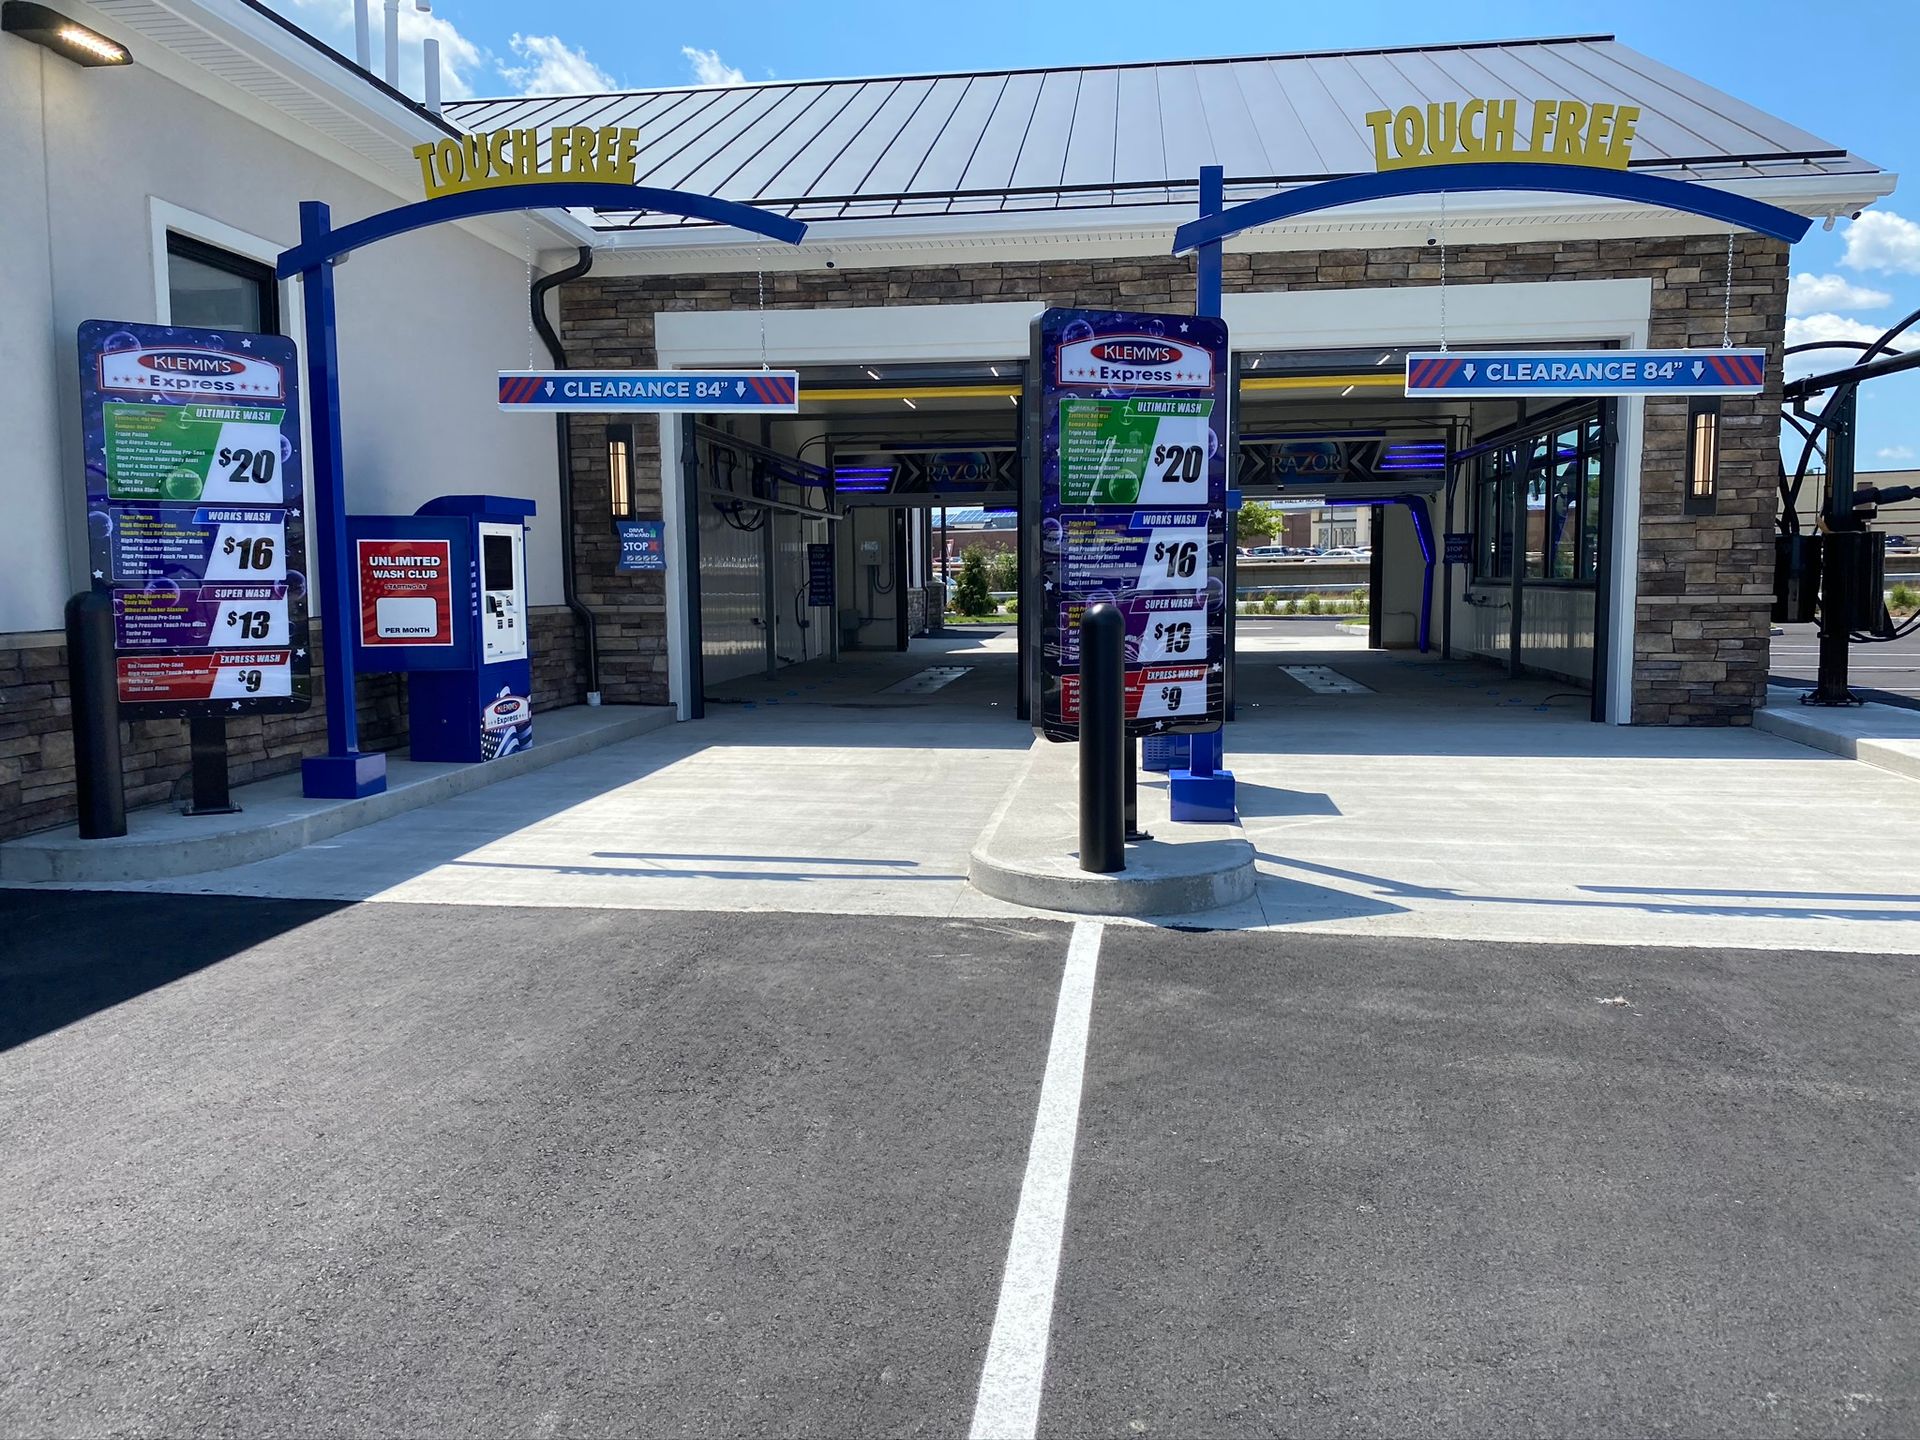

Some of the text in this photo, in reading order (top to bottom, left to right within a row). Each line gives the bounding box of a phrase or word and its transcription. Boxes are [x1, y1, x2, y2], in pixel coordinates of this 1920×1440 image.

[1366, 98, 1641, 172] TOUCH FREE
[413, 126, 639, 198] TOUCH FREE
[1104, 345, 1170, 361] KLEMM'S
[153, 356, 232, 373] KLEMM'S
[1485, 362, 1637, 382] CLEARANCE
[1100, 366, 1172, 382] Express
[150, 374, 235, 392] Express
[563, 381, 691, 399] CLEARANCE
[195, 408, 271, 421] ULTIMATE WASH
[1137, 401, 1202, 413] ULTIMATE WASH
[218, 447, 275, 484] $20
[1154, 444, 1204, 483] $20
[1270, 454, 1342, 473] RAZOR
[925, 464, 991, 482] RAZOR
[208, 511, 271, 521] WORKS WASH
[1142, 515, 1198, 525] WORKS WASH
[223, 536, 274, 570] $16
[623, 542, 648, 551] STOP
[368, 555, 441, 568] UNLIMITED
[1154, 541, 1198, 579] $16
[372, 568, 438, 580] WASH CLUB
[215, 589, 271, 598] SUPER WASH
[1145, 598, 1194, 609] SUPER WASH
[226, 610, 271, 639] $13
[402, 626, 431, 634] MONTH
[1154, 622, 1192, 653] $13
[220, 654, 281, 664] EXPRESS WASH
[238, 670, 262, 692] $9
[1147, 670, 1200, 681] EXPRESS WASH
[1161, 686, 1183, 711] $9
